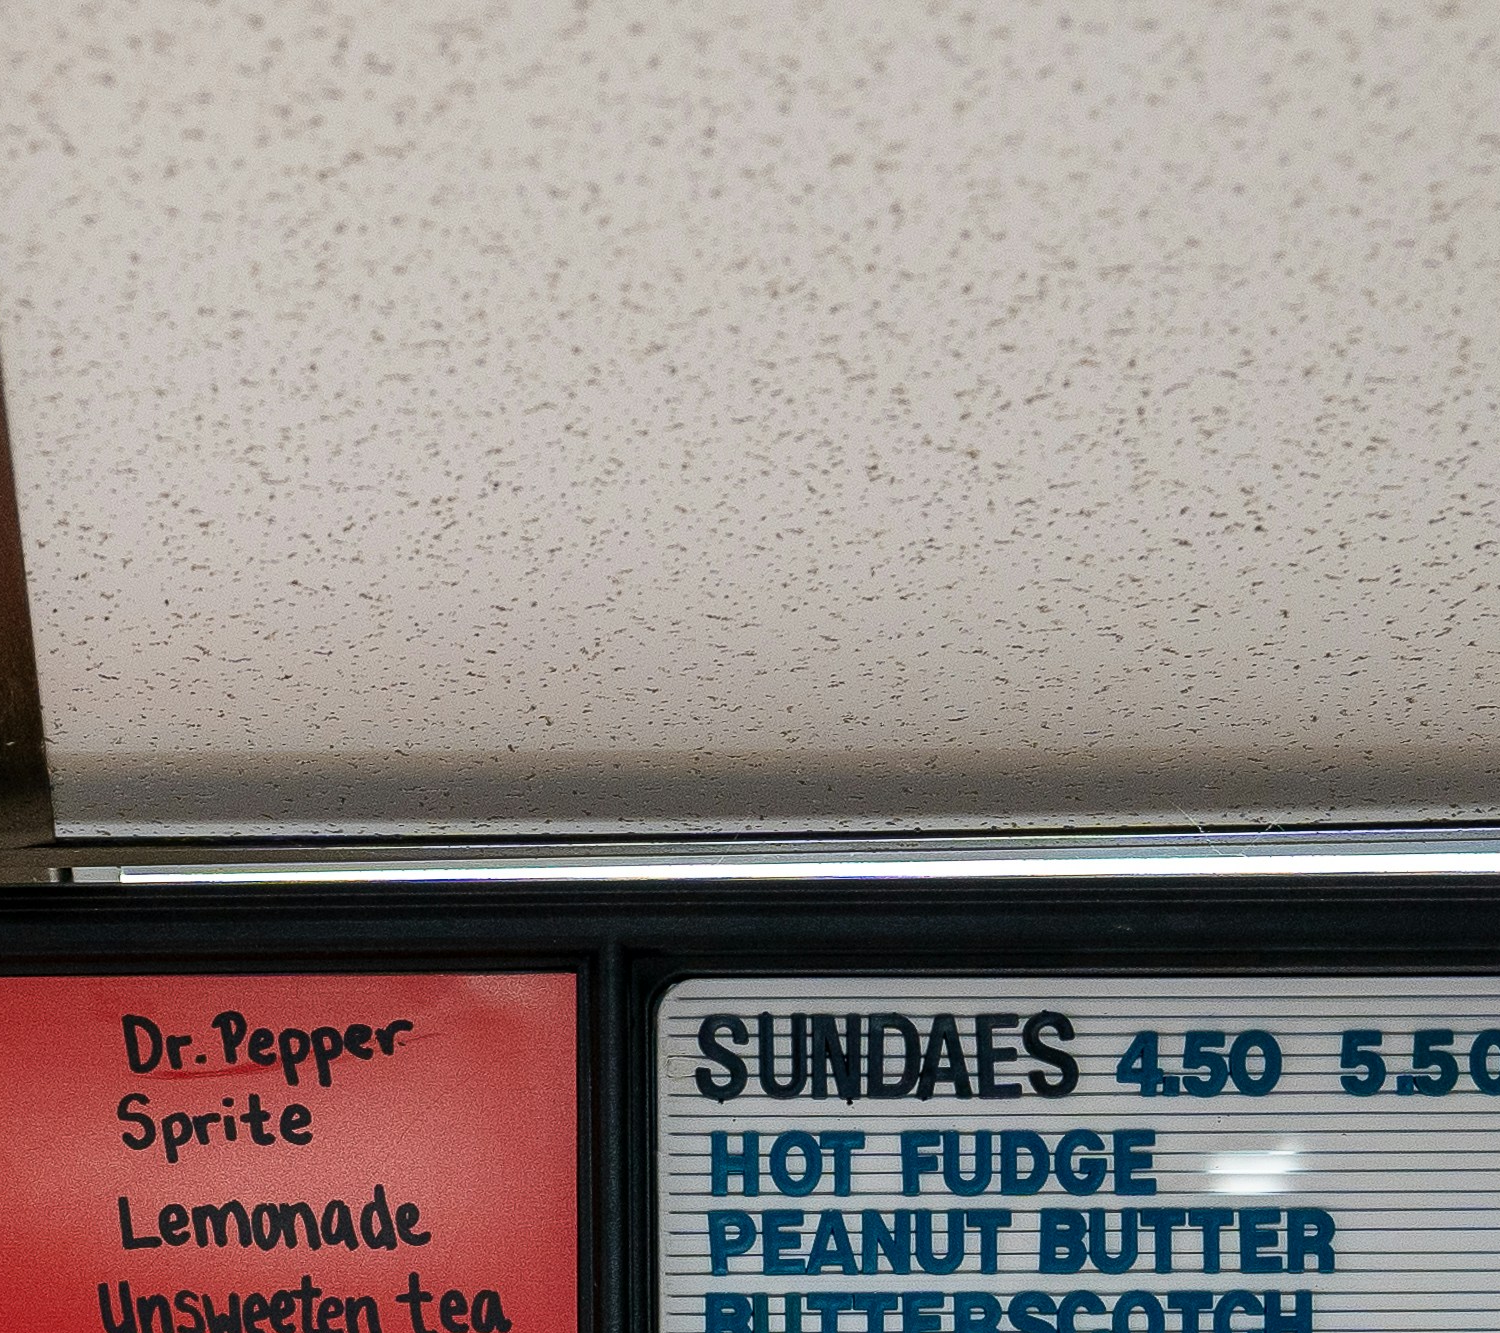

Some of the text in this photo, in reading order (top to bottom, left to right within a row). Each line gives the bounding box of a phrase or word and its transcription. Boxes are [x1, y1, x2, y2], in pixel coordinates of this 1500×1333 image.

[219, 1011, 414, 1087] Pepper
[694, 1011, 1079, 1104] SUNDAES
[1115, 1028, 1282, 1098] 4.50
[116, 1092, 313, 1162] Sprite
[709, 1129, 1158, 1197] HOT FUDGE
[118, 1184, 430, 1252] Lemonade
[708, 1207, 1337, 1276] PEANUT BUTTER
